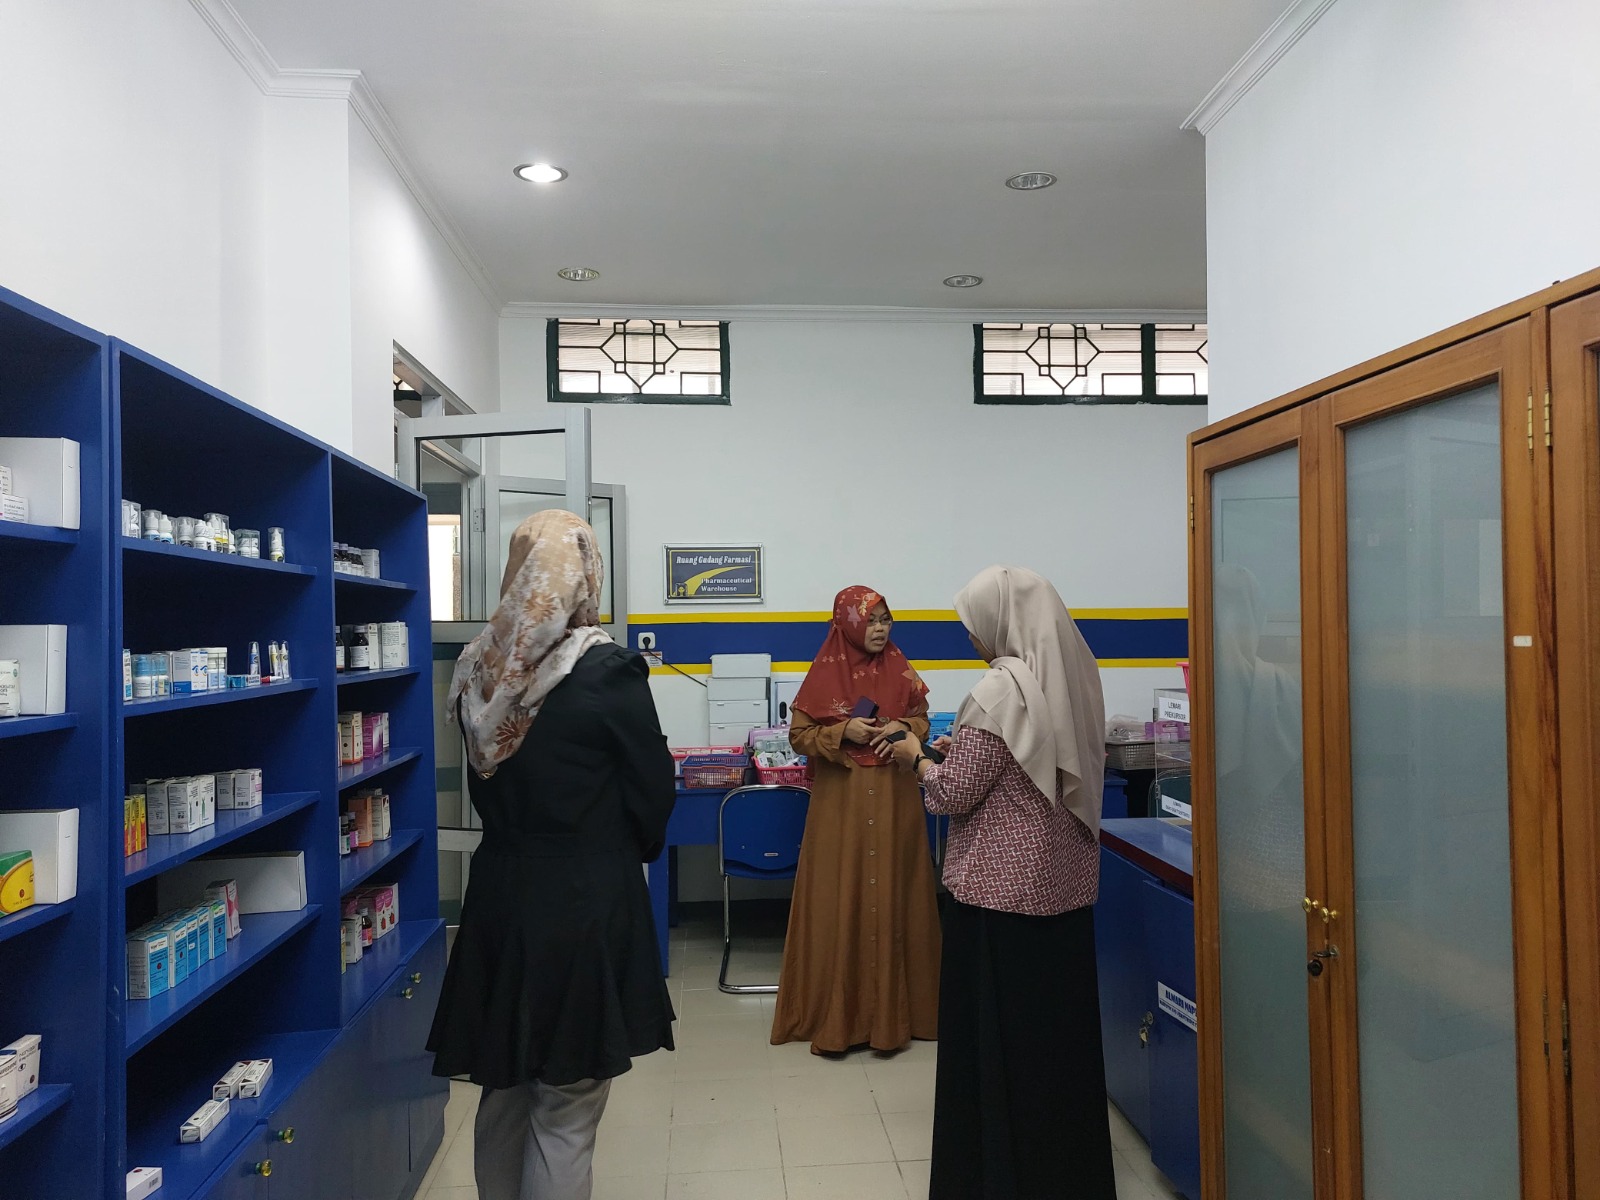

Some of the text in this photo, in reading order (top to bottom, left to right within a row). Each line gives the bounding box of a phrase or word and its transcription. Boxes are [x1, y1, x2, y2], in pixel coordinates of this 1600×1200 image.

[676, 555, 752, 565] Ruang Gudang Farmasi
